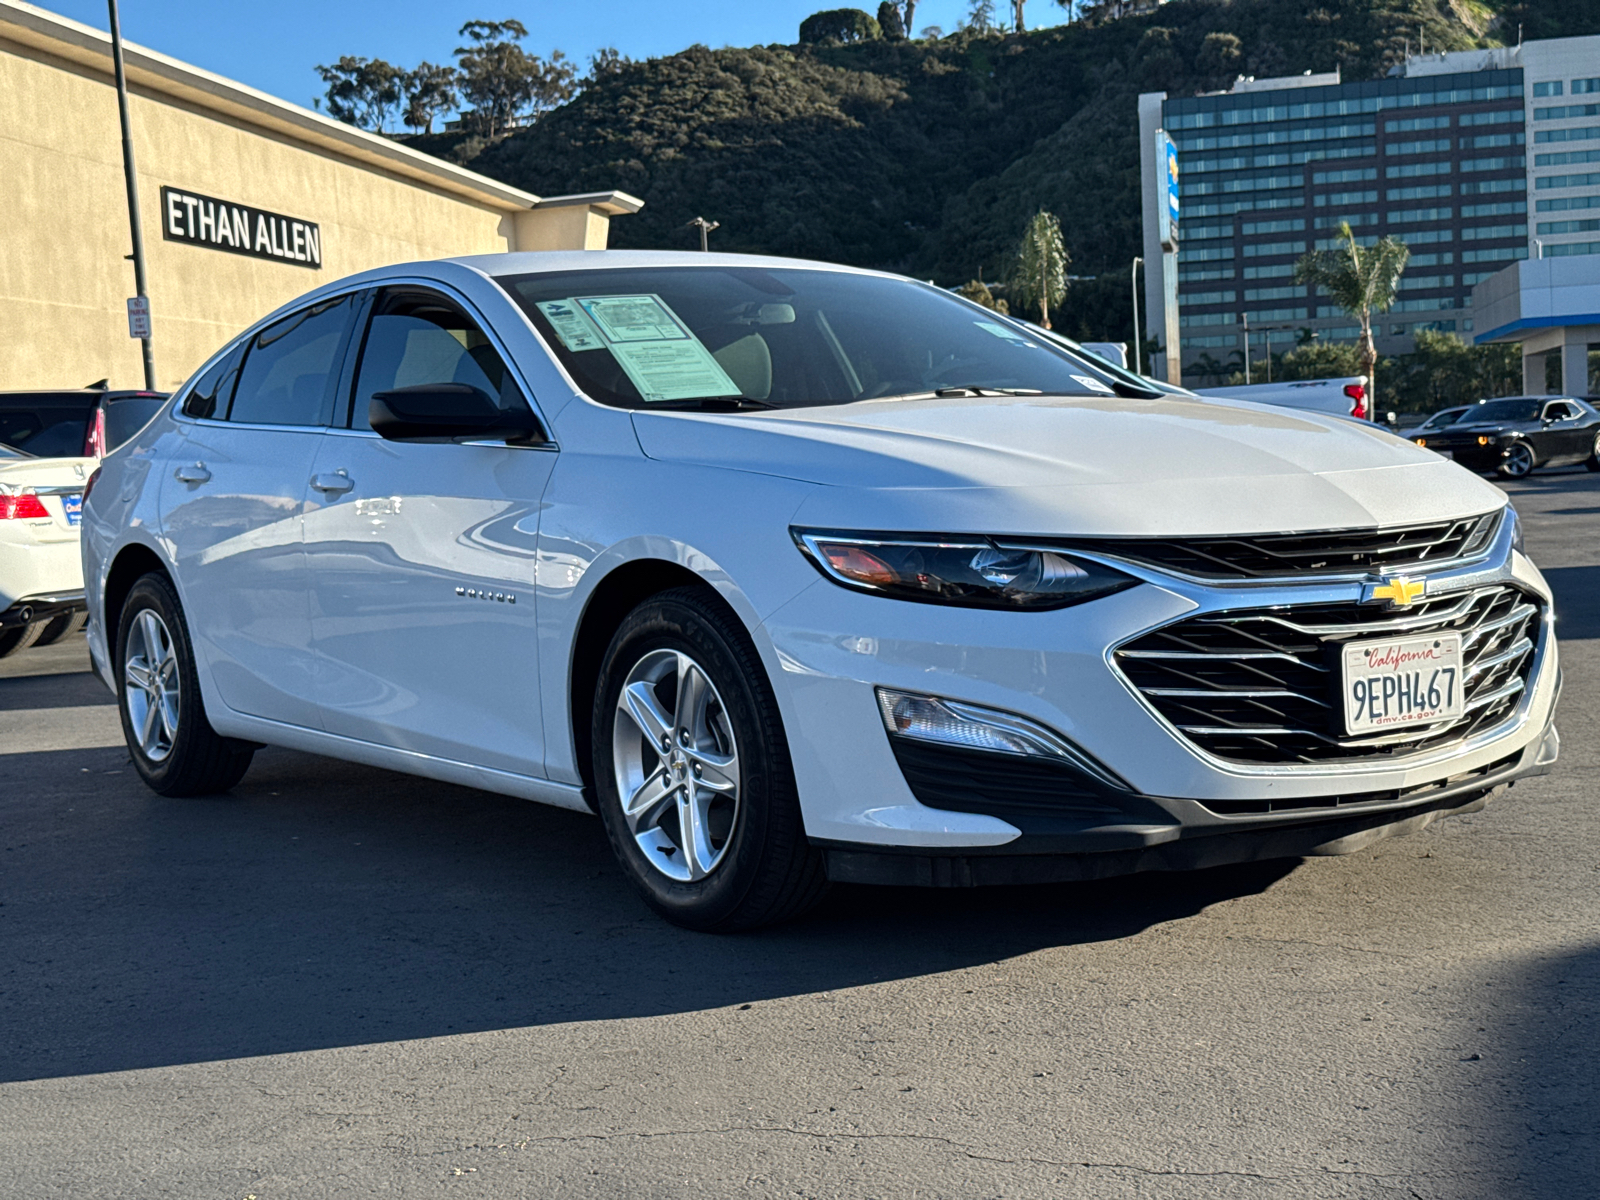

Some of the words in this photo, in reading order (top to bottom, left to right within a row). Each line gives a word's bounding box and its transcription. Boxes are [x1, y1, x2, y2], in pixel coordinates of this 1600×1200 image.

[167, 191, 251, 250] ETHAN
[255, 213, 321, 264] ALLEN
[1368, 645, 1442, 671] California
[1353, 668, 1455, 722] 9EPH467
[1376, 710, 1436, 725] dmv.ca.gov
